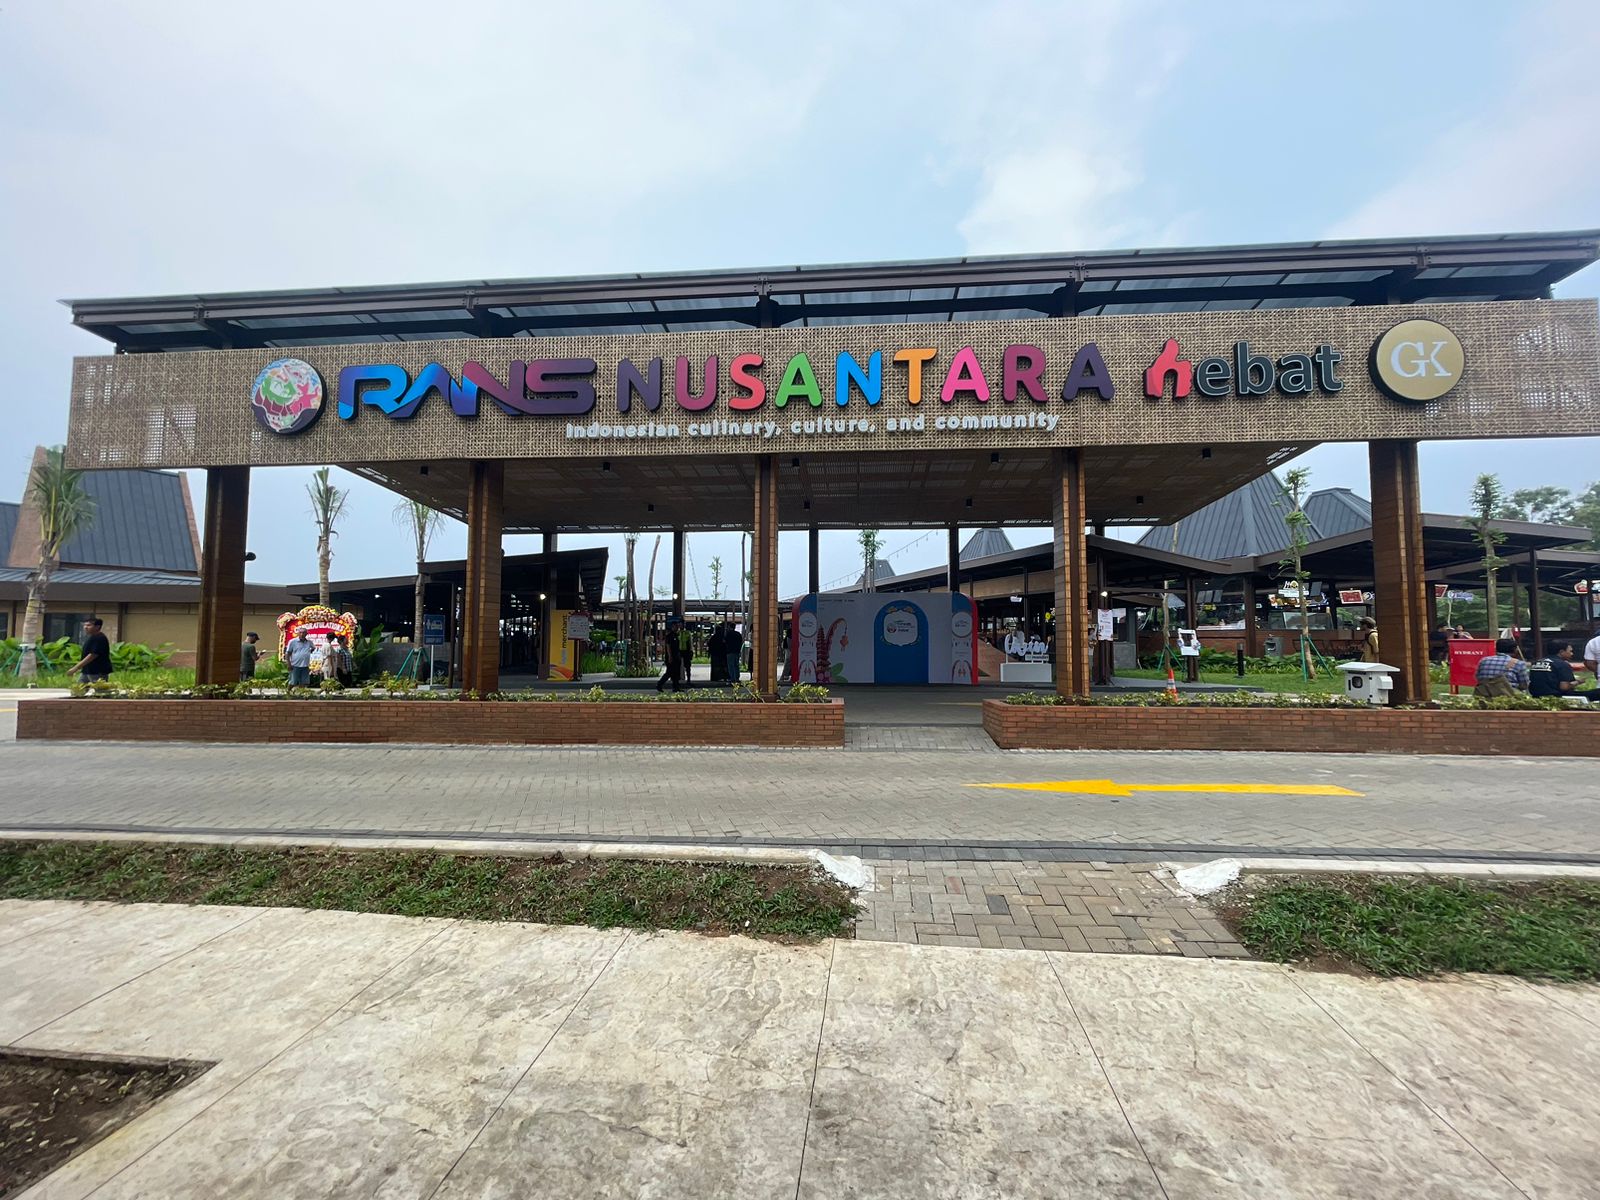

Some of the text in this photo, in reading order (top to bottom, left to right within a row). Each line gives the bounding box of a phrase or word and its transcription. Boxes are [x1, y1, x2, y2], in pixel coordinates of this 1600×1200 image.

[1144, 337, 1343, 398] hebat
[1390, 340, 1452, 378] GK
[337, 341, 1115, 420] RANS NUSANTARA
[566, 411, 1060, 439] Indonesian culinary, culture, and community
[1454, 649, 1485, 657] HYDRANT
